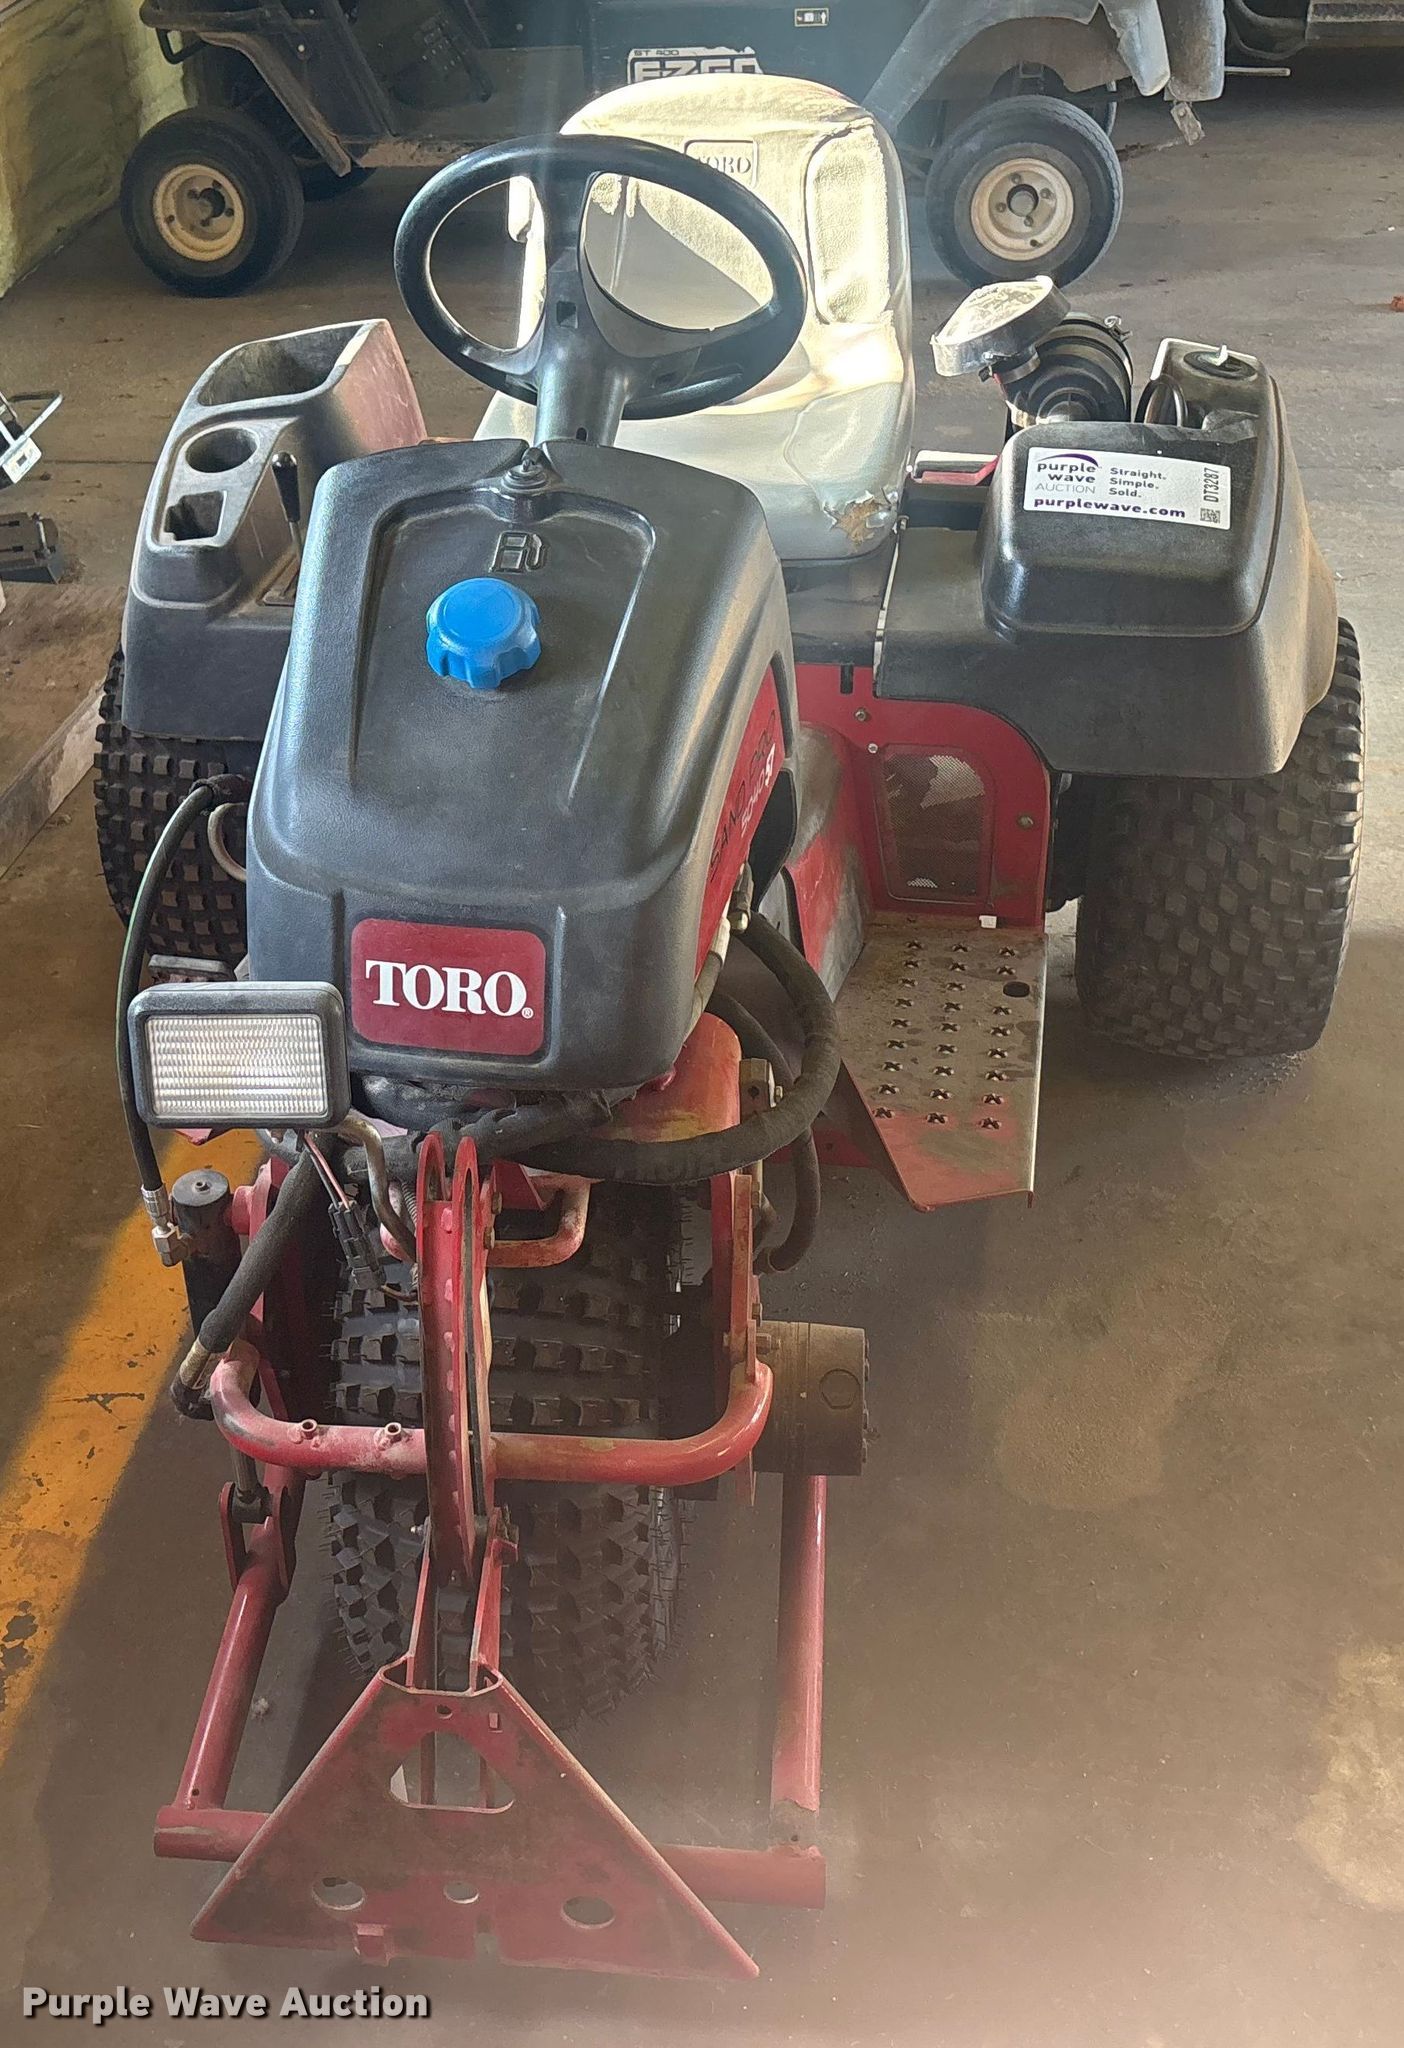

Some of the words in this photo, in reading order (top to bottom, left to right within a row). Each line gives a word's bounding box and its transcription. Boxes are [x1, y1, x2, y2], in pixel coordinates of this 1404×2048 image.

[697, 156, 752, 174] ORO
[1036, 461, 1098, 474] purple
[1110, 467, 1167, 480] Straight.
[1047, 473, 1097, 484] wave
[1109, 477, 1160, 490] Simple.
[1203, 467, 1220, 503] DT3287
[1034, 483, 1097, 494] AUCTION
[1108, 487, 1142, 498] Sold.
[1033, 498, 1186, 518] purplewave.com
